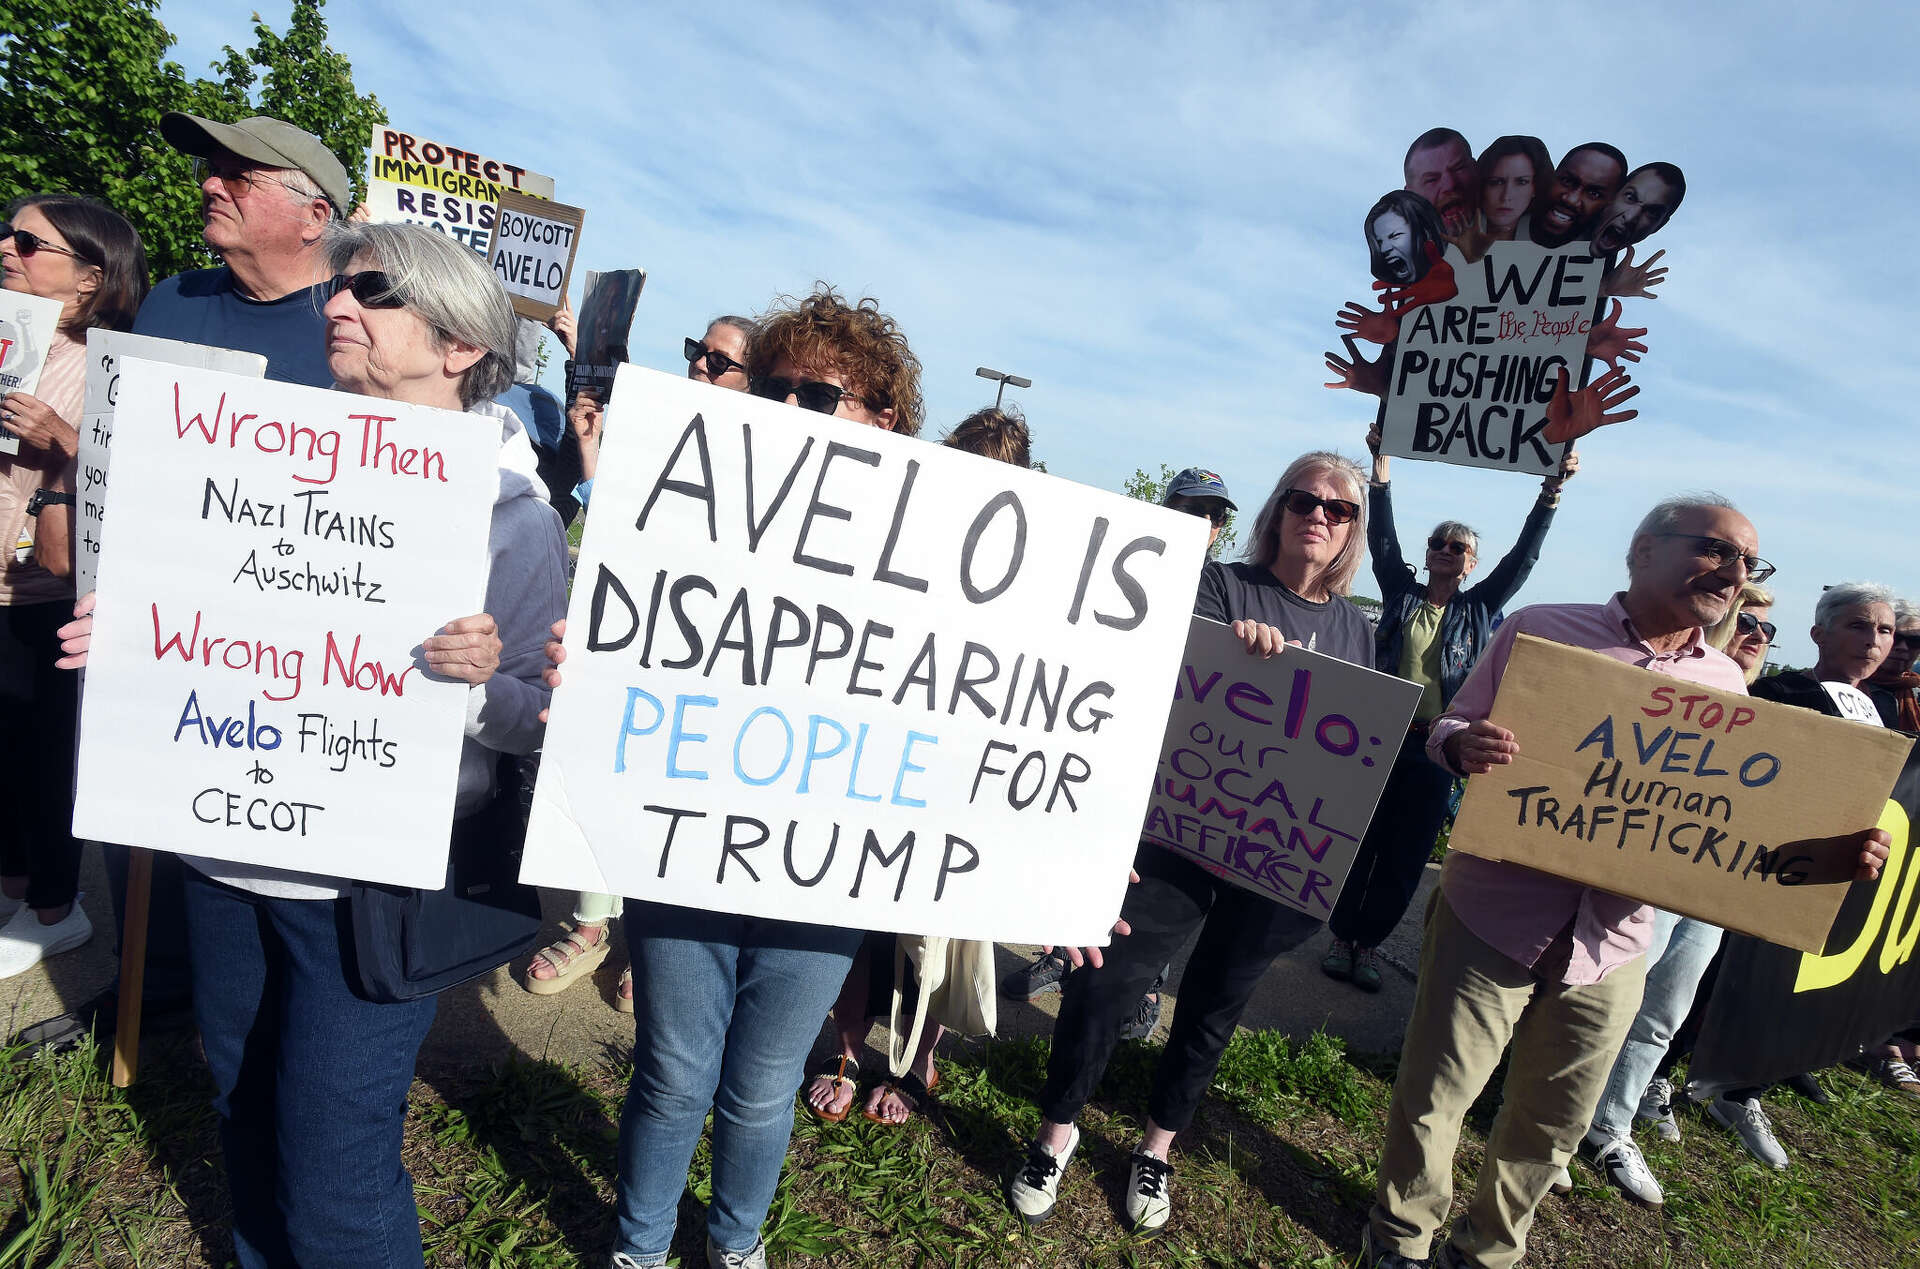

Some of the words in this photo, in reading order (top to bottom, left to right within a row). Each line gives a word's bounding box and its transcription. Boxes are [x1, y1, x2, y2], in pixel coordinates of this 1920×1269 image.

[374, 156, 548, 203] IMMIGRAN
[383, 130, 526, 188] PROTECT
[396, 188, 496, 229] RESIS
[500, 212, 574, 248] BOYCOTT
[494, 249, 563, 291] AVELO
[1483, 254, 1595, 307] WE
[1406, 305, 1498, 345] ARE
[1497, 310, 1528, 343] the
[1527, 310, 1592, 345] People
[1397, 350, 1568, 405] PUSHING
[173, 381, 341, 485] Wrong
[348, 413, 449, 482] Then
[1412, 401, 1554, 468] BACK
[272, 537, 295, 556] to
[634, 411, 1027, 604] AVELO
[1066, 515, 1167, 631] IS
[233, 549, 386, 603] Auschwitz
[152, 602, 304, 701] Wrong
[322, 631, 416, 697] Now
[586, 562, 1115, 734] DISAPPEARING
[174, 689, 282, 751] Avelo
[297, 713, 397, 772] Flights
[1174, 664, 1383, 768] velo:
[1640, 686, 1756, 734] STOP
[246, 759, 274, 784] to
[613, 686, 939, 809] PEOPLE
[968, 739, 1092, 814] FOR
[1574, 714, 1782, 788] AVELO
[192, 787, 325, 837] CECOT
[1159, 748, 1359, 843] OCAL
[1584, 758, 1732, 824] Human
[642, 804, 981, 903] TRUMP
[1506, 785, 1815, 886] TRAFFICKING
